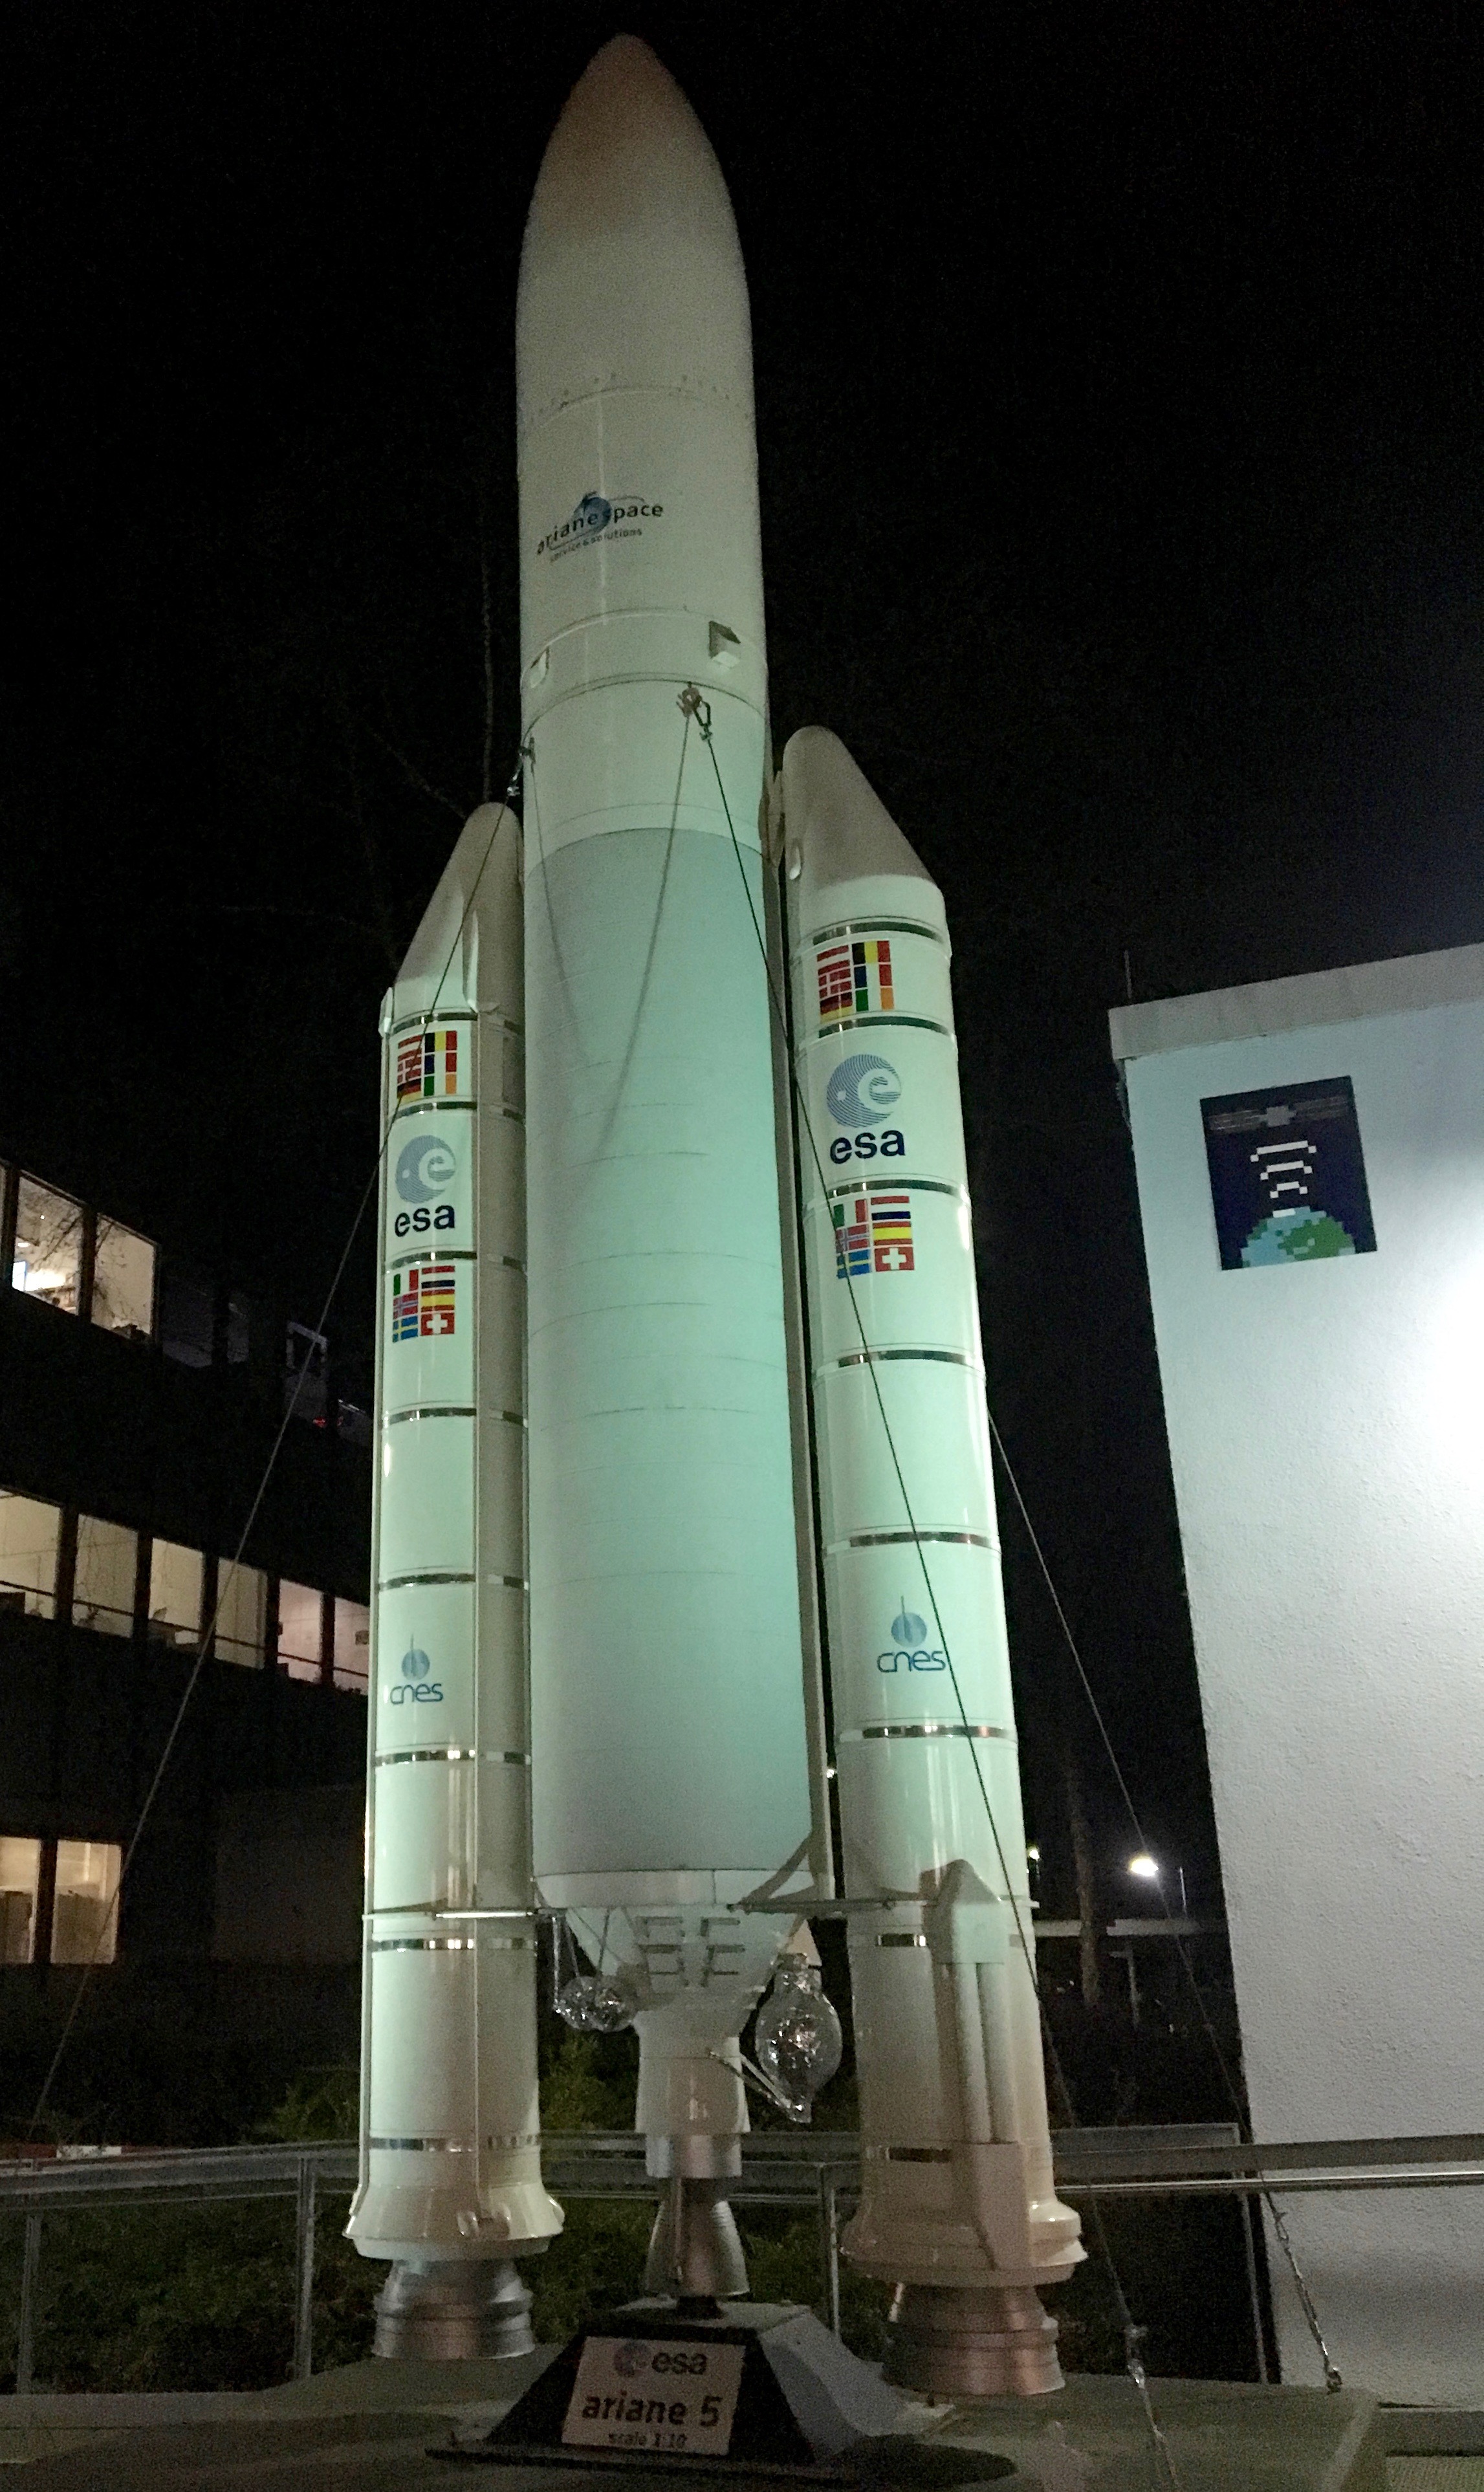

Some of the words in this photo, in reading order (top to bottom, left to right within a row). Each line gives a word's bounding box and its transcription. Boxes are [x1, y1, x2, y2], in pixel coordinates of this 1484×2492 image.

[829, 1130, 906, 1164] esa
[394, 1205, 455, 1238] esa
[876, 1650, 946, 1673] cnes
[389, 1683, 444, 1705] cnes
[651, 2352, 708, 2375] esa
[582, 2390, 687, 2425] ariane
[699, 2395, 723, 2427] 5
